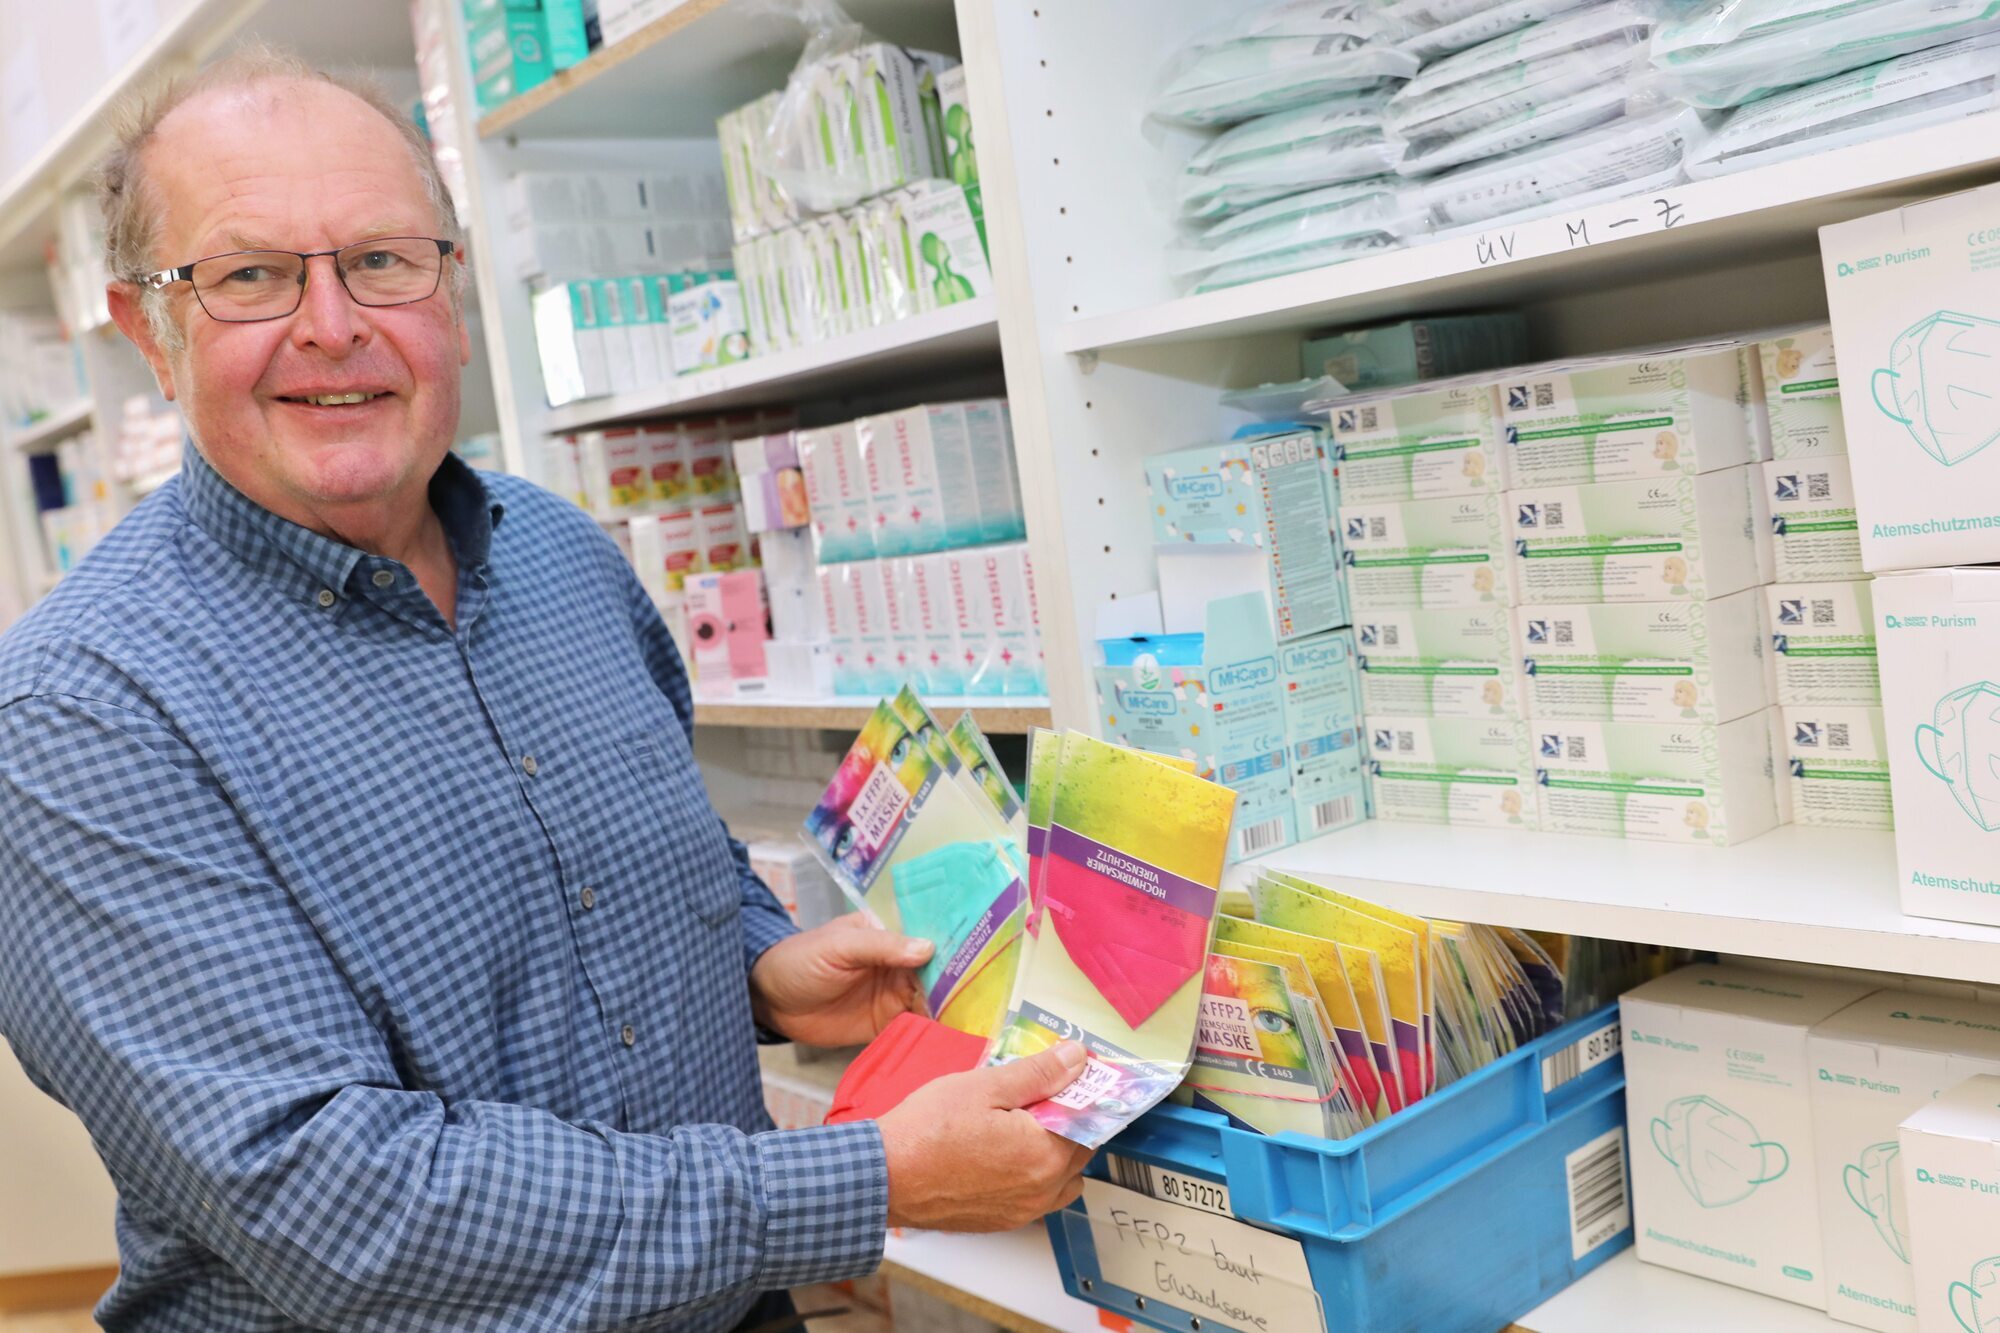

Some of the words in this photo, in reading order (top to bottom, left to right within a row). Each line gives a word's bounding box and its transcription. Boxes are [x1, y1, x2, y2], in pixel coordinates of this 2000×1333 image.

[1566, 219, 1591, 246] M
[1654, 198, 1685, 229] Z
[1884, 246, 1931, 266] Purism
[895, 418, 914, 486] nasic
[915, 562, 932, 630] nasic
[950, 558, 969, 629] nasic
[985, 556, 1005, 627] nasic
[1931, 614, 1977, 628] Purism
[1291, 646, 1337, 666] MHCare
[1218, 666, 1268, 687] MHCare
[1128, 697, 1168, 710] MHCare
[865, 770, 889, 804] FFP2
[870, 789, 905, 841] MASKE
[1086, 857, 1167, 899] HOCHWIRKSAMER
[1096, 849, 1159, 884] VIRENSCHUTZ
[952, 924, 992, 977] VIRENSCHUTZ
[1038, 1013, 1059, 1029] 0598
[1200, 1018, 1248, 1034] TEMSCHUTZ
[1210, 1001, 1246, 1021] FFP2
[1200, 1028, 1254, 1051] MASKE
[1665, 1038, 1699, 1052] Purism
[1272, 1067, 1293, 1079] 1463
[1859, 1077, 1901, 1094] Purism
[1163, 1175, 1179, 1197] 80
[1184, 1182, 1227, 1211] 57272
[1970, 1178, 2000, 1195] Puri
[1110, 1207, 1192, 1256] FFP2
[1646, 1228, 1757, 1268] Atemschutzmaske
[1837, 1284, 1917, 1317] Atemschut
